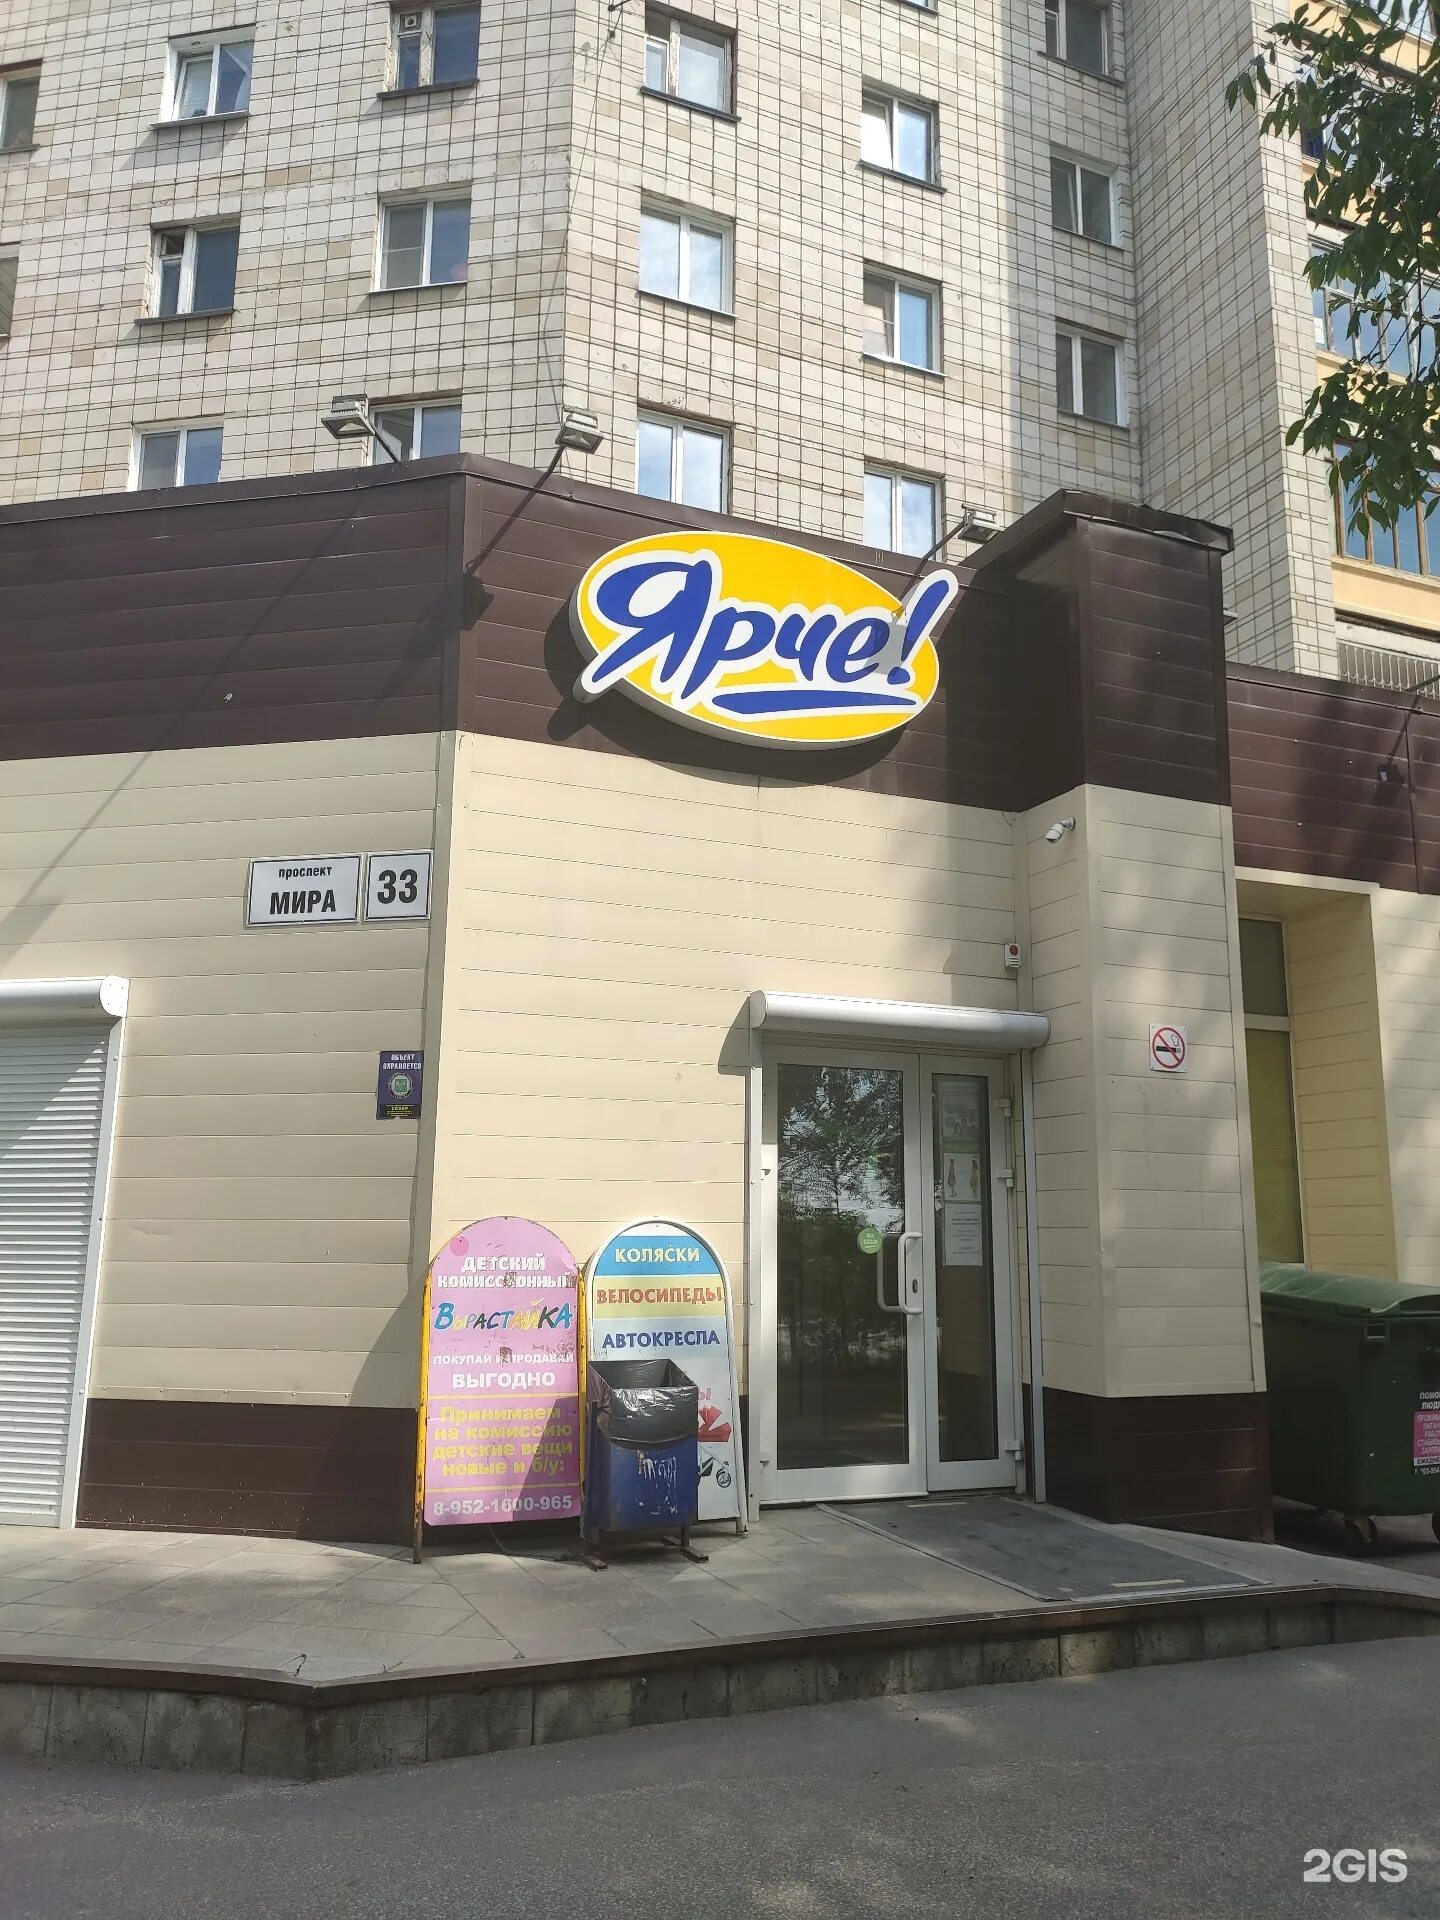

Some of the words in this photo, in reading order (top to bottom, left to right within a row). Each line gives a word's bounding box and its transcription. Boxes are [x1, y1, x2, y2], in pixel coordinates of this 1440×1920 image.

[588, 556, 953, 702] Ярче!
[278, 866, 332, 880] проспект
[377, 869, 418, 904] 33
[269, 889, 336, 915] МИРА
[390, 1053, 416, 1061] ОБЪЕКТ
[461, 1252, 546, 1273] ДЕТСКИЙ
[614, 1247, 700, 1263] КОЛЯСКИ
[596, 1286, 723, 1305] ВЕЛОСИПЕДЫ
[601, 1329, 721, 1349] АВТОКРЕСЛА
[433, 1353, 493, 1365] ПОКУПАЙ
[452, 1371, 556, 1389] ВЫГОДНО
[1419, 1391, 1440, 1400] ПОМО
[440, 1406, 561, 1425] Принимаем
[434, 1428, 459, 1440] на
[466, 1424, 573, 1439] комиссию
[432, 1443, 515, 1461] детские
[521, 1440, 573, 1456] вещи
[442, 1461, 508, 1476] новые
[513, 1461, 526, 1474] и
[532, 1456, 565, 1475] б/у:
[433, 1494, 573, 1516] 8-952-1600-965
